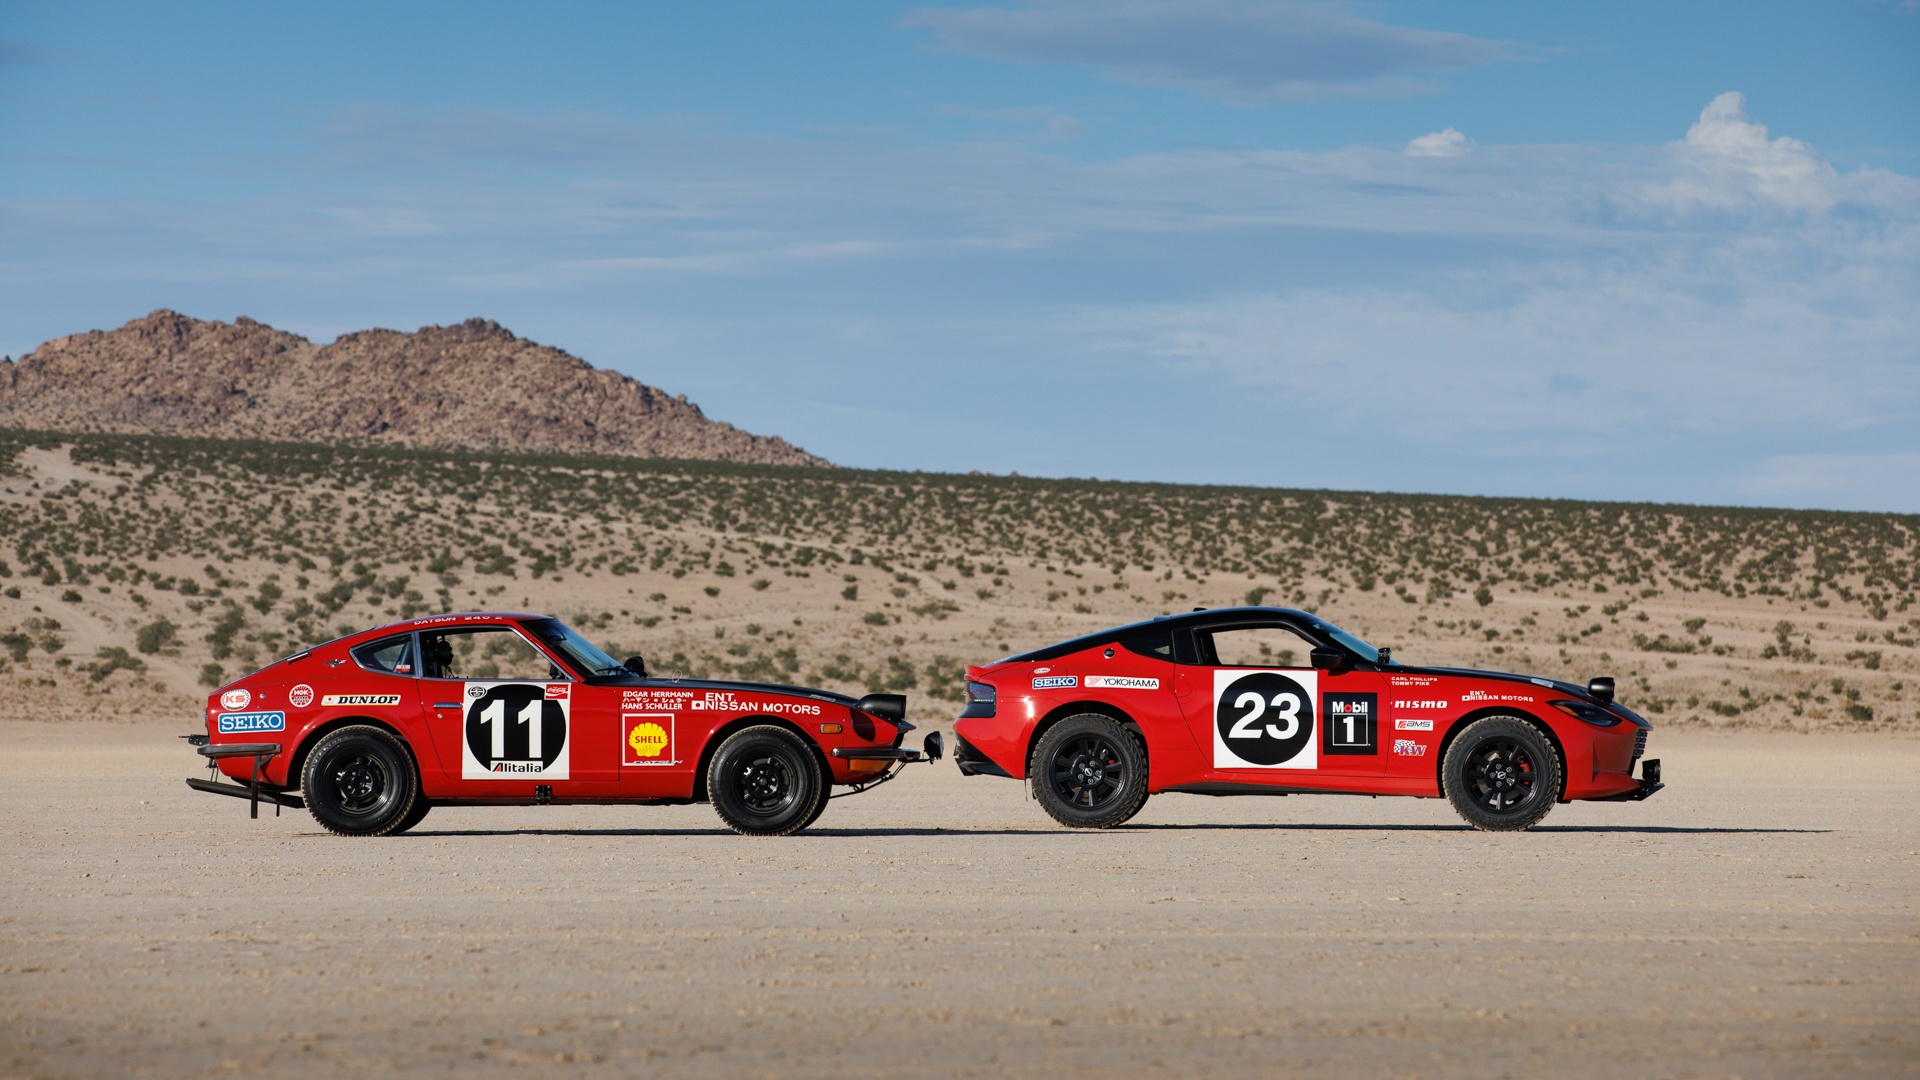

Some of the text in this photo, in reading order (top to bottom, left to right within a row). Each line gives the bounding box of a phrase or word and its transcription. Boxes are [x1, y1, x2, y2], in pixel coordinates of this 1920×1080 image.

[414, 616, 456, 625] DATSUN
[1034, 677, 1075, 687] SEIKO
[1103, 677, 1158, 687] YOKOHAMA
[225, 694, 246, 704] KS
[337, 695, 398, 705] DUNLOP
[705, 692, 736, 702] ENT.
[621, 702, 683, 710] HANS SCHULLER
[705, 700, 821, 715] NISSAN MOTORS
[1332, 701, 1368, 713] Mobil
[1228, 691, 1301, 740] 23
[221, 714, 282, 730] SEIKO
[480, 699, 542, 758] 11
[1342, 716, 1355, 743] 1
[634, 735, 663, 744] SHELL
[1399, 744, 1427, 756] KW
[491, 762, 542, 773] Alitalia
